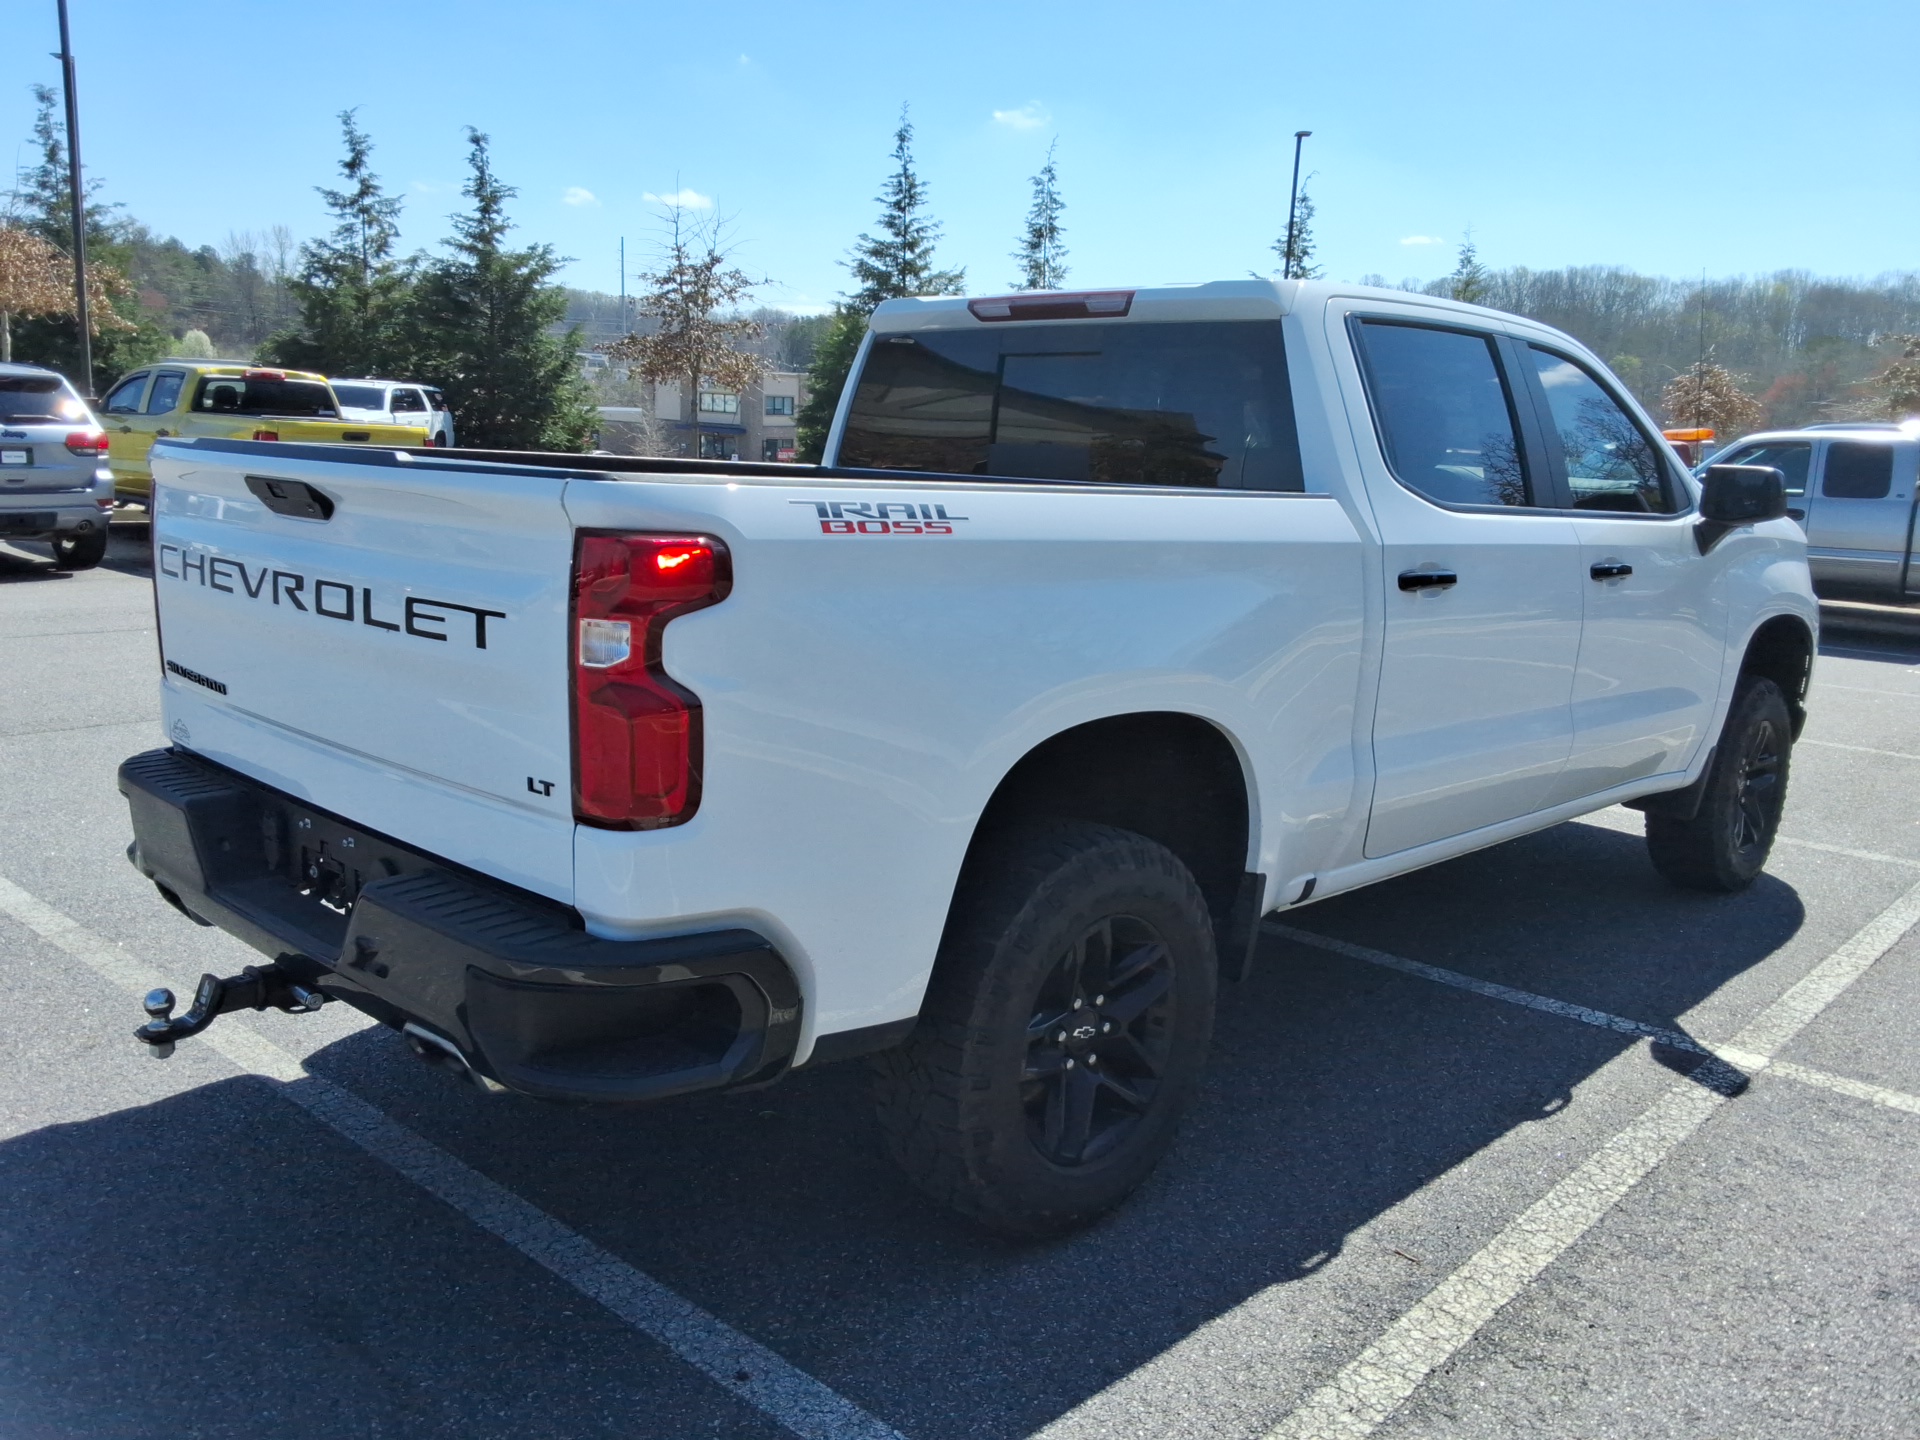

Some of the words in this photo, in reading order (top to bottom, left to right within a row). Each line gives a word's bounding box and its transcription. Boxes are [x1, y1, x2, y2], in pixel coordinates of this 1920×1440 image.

[788, 500, 969, 520] TRAIL
[820, 520, 953, 534] BOSS
[160, 543, 507, 650] CHEVROLET
[527, 776, 555, 797] LT
